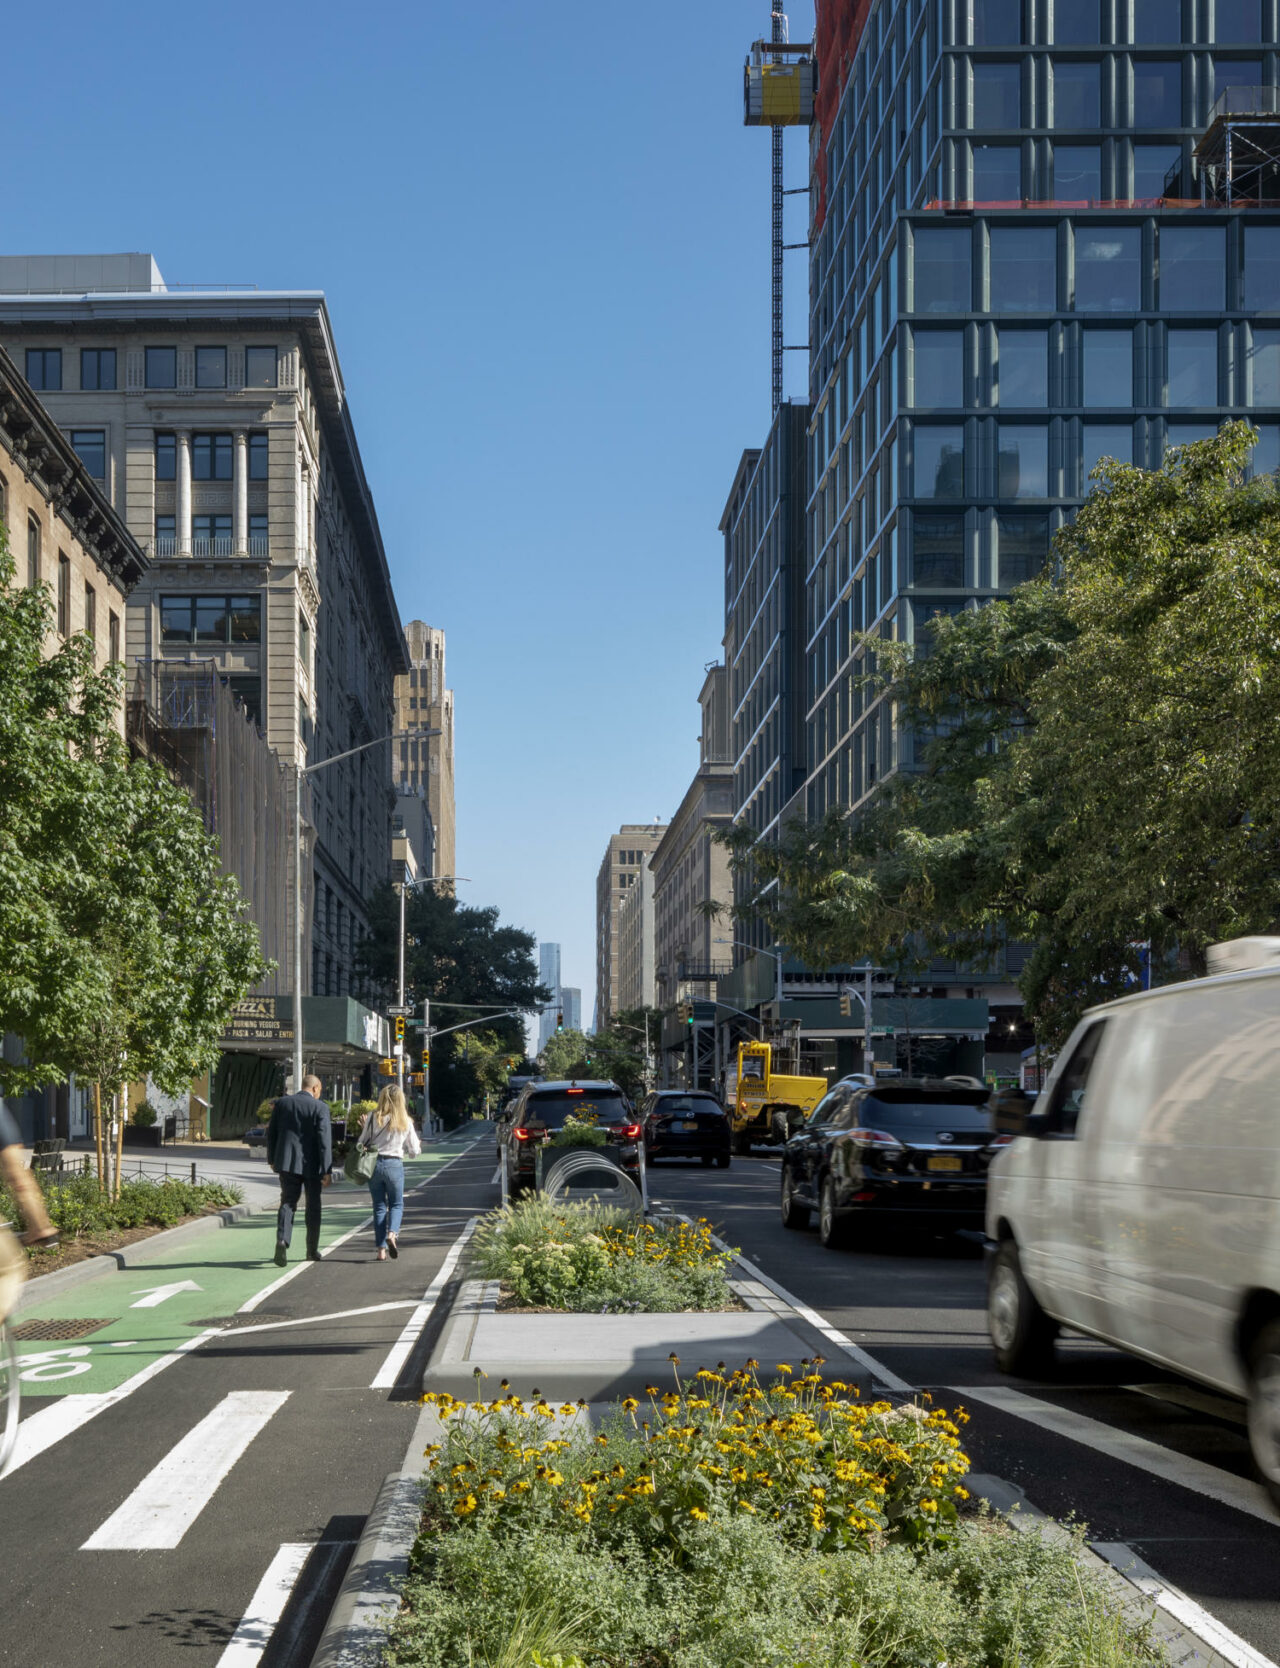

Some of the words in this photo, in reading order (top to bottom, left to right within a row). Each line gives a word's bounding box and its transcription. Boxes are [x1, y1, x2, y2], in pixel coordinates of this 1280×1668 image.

[230, 1002, 266, 1013] PIZZA
[259, 1020, 280, 1029] VEGGIES
[232, 1029, 249, 1038] PASTA
[255, 1030, 273, 1038] SALAD
